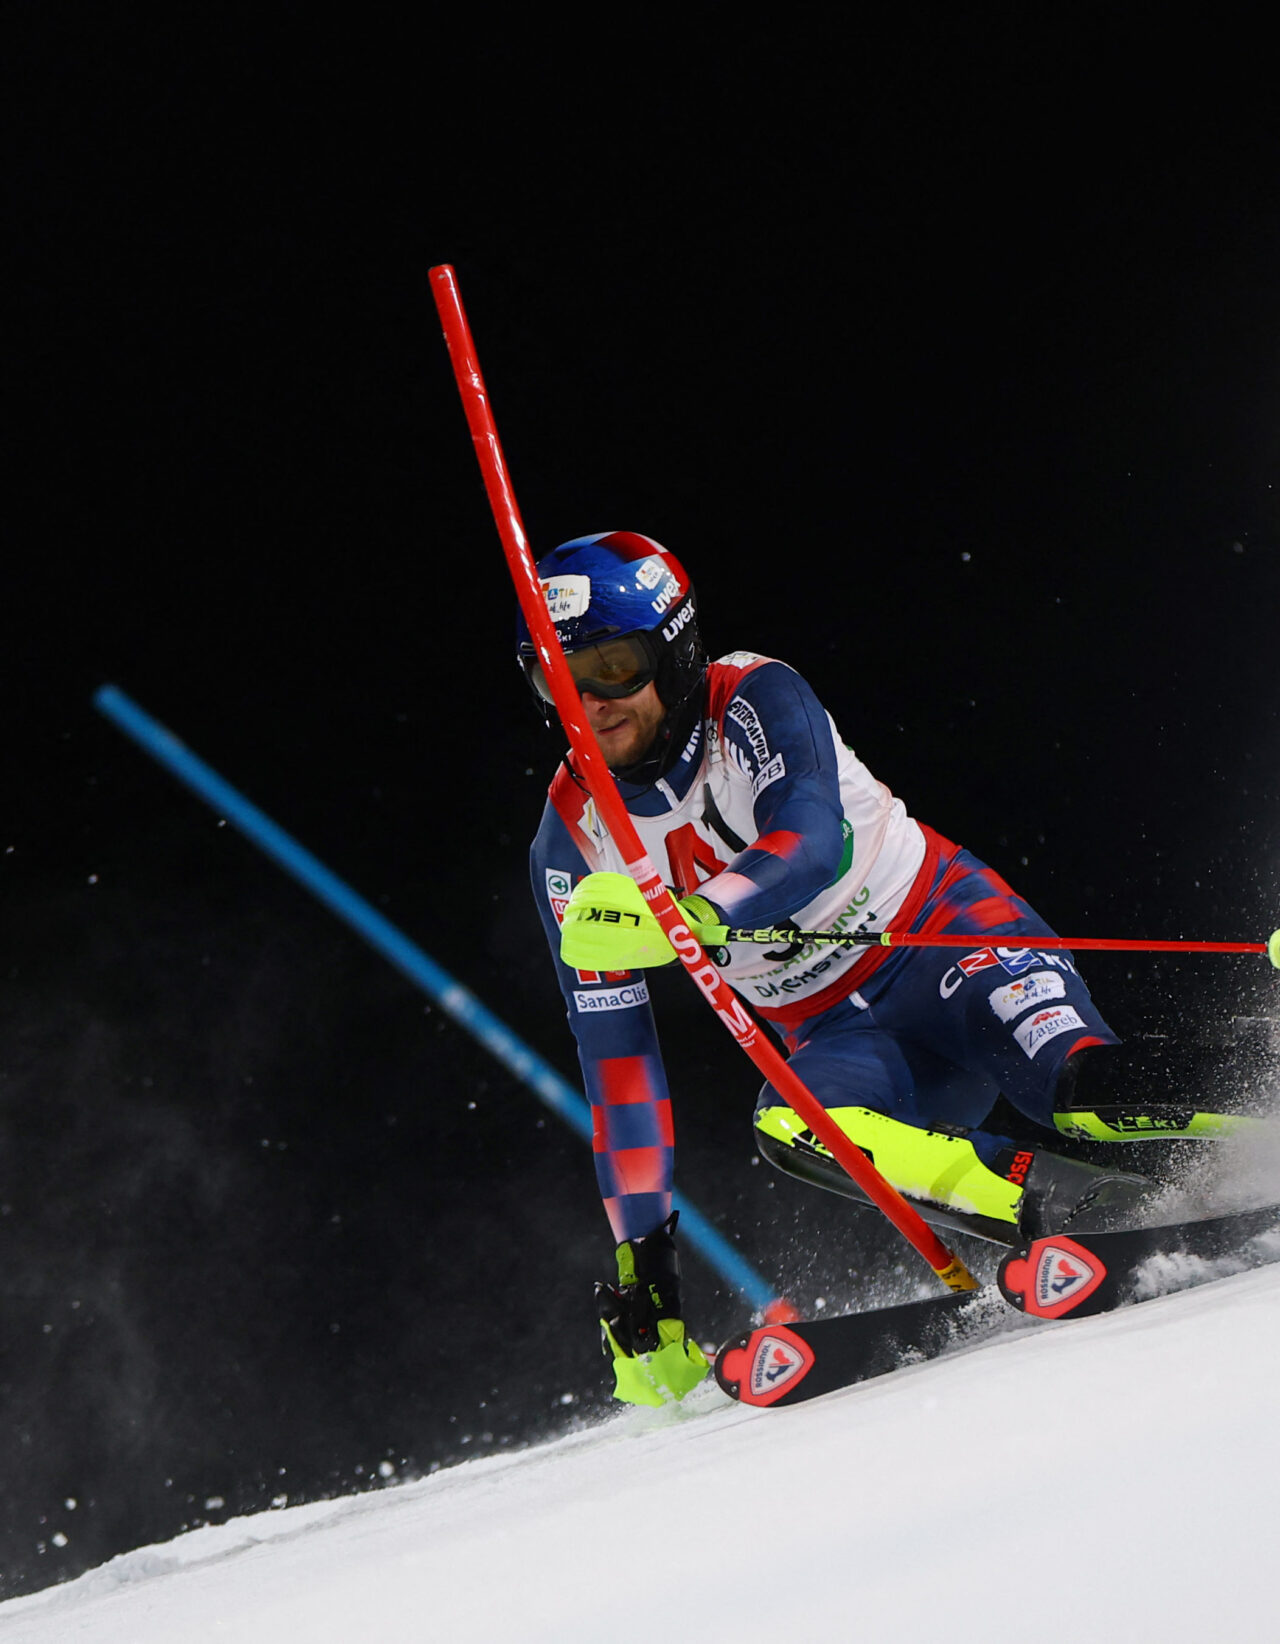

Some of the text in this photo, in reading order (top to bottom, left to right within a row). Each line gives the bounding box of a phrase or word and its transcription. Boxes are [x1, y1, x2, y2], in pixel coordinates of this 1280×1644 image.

[651, 574, 681, 614] uvex
[662, 598, 696, 642] uvex
[576, 908, 641, 927] LEKI
[736, 928, 795, 943] LEKI
[578, 987, 648, 1009] SanaClis
[668, 924, 753, 1036] SPM
[1024, 1015, 1078, 1048] Zagreb
[1007, 1151, 1034, 1185] OSSI
[1041, 1255, 1054, 1299] ROSSIGNOL
[756, 1343, 772, 1388] ROSSIGNOL
